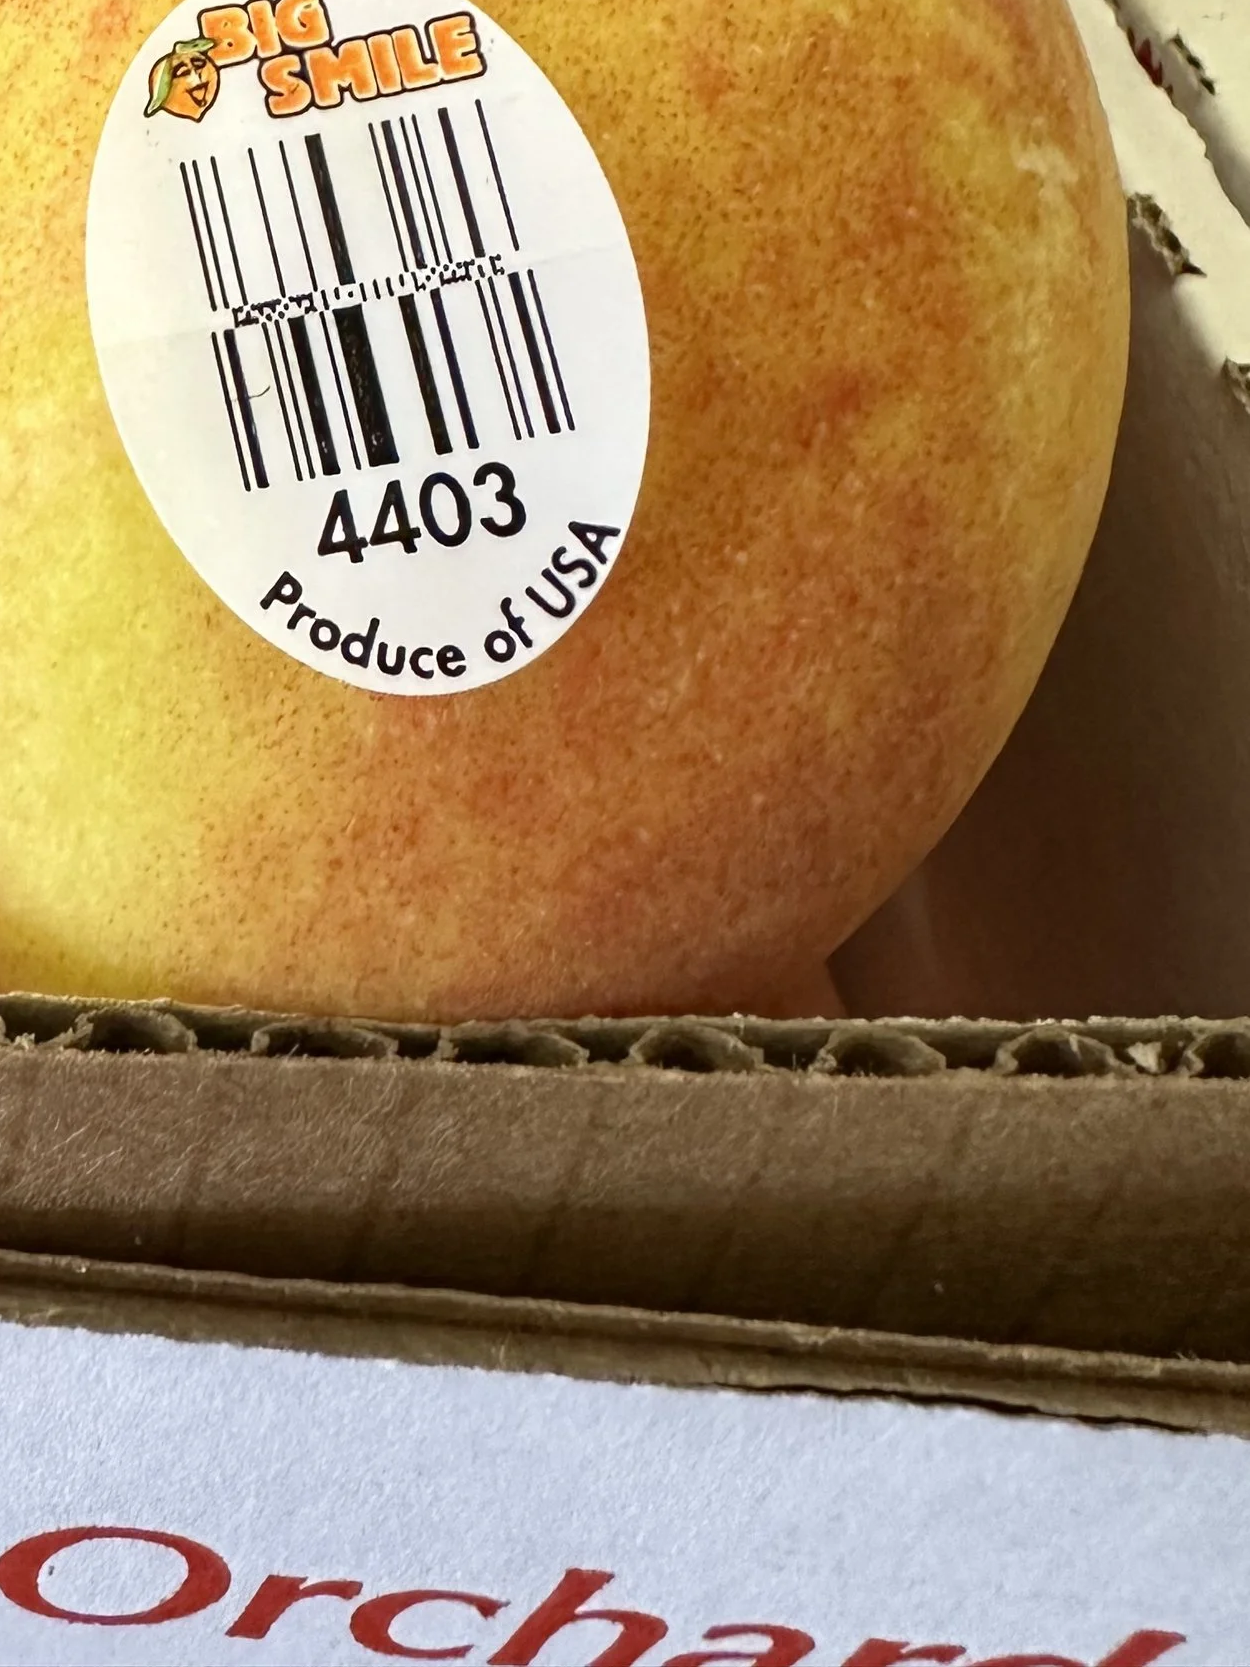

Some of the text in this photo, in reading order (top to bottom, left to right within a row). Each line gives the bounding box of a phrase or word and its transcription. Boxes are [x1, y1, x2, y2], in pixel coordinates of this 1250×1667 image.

[260, 10, 488, 118] SMILE
[316, 463, 527, 564] 4403
[260, 519, 622, 680] Produce of USA
